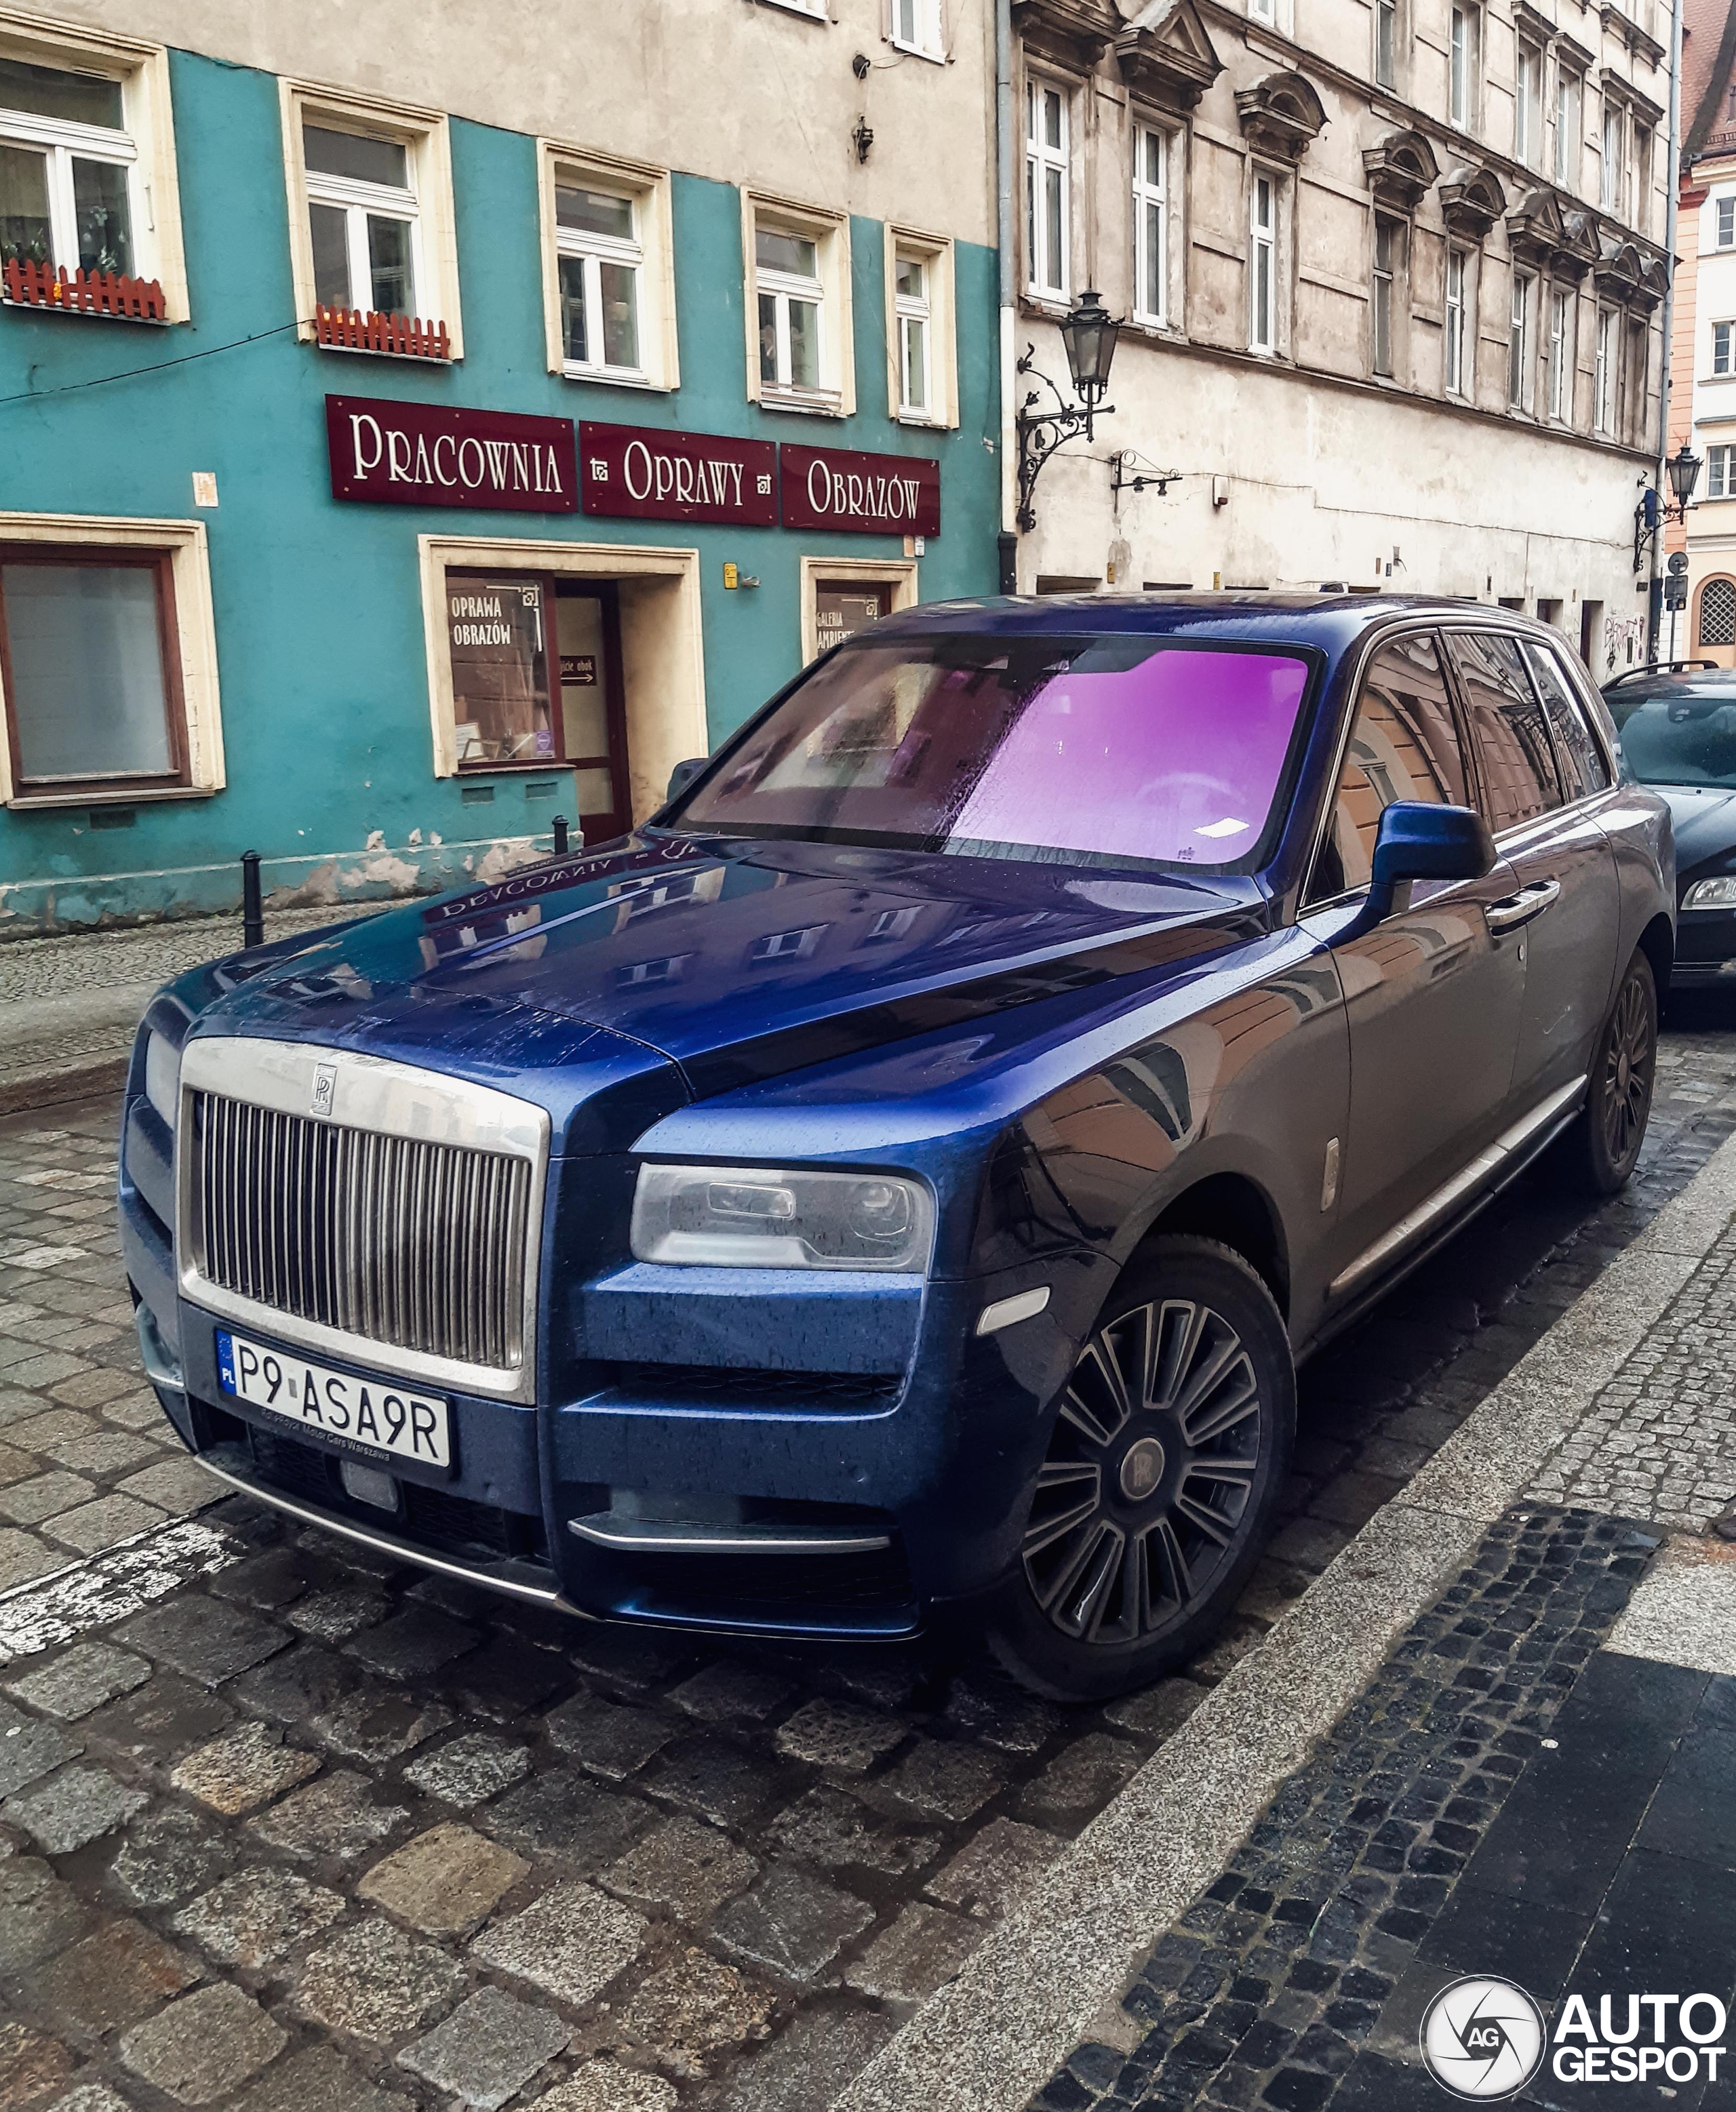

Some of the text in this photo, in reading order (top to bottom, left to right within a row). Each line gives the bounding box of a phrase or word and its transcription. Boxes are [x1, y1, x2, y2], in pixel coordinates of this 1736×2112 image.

[349, 414, 920, 520] PRACOWNIA OPRAWY OBRAZÓW
[452, 597, 502, 618] OPRAWA
[454, 620, 511, 645] OBRAZÓW
[222, 1367, 235, 1384] PL
[238, 1344, 439, 1459] P9 ASA9R
